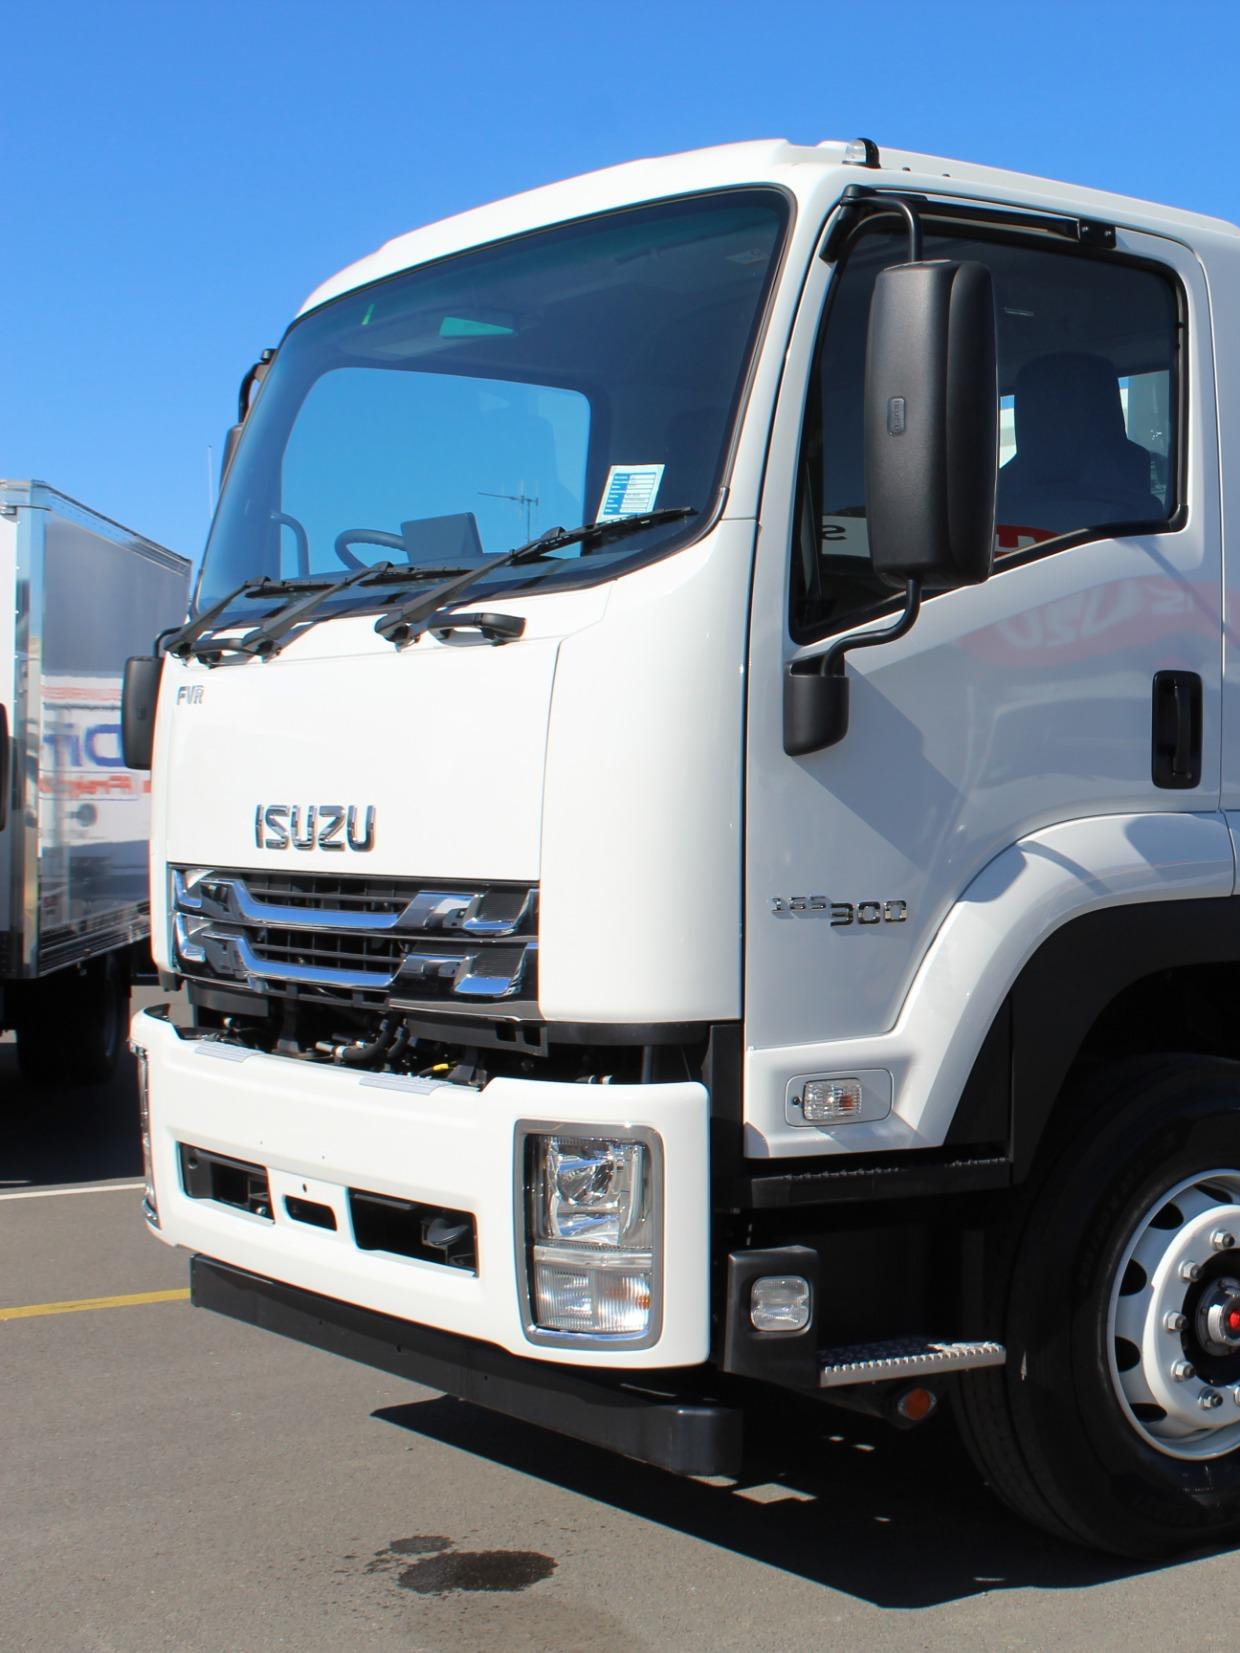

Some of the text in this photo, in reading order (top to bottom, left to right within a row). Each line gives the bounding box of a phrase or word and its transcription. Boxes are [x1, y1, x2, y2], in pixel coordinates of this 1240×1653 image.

[177, 685, 205, 705] FVR
[255, 804, 376, 852] ISUZU
[830, 900, 907, 926] 300
